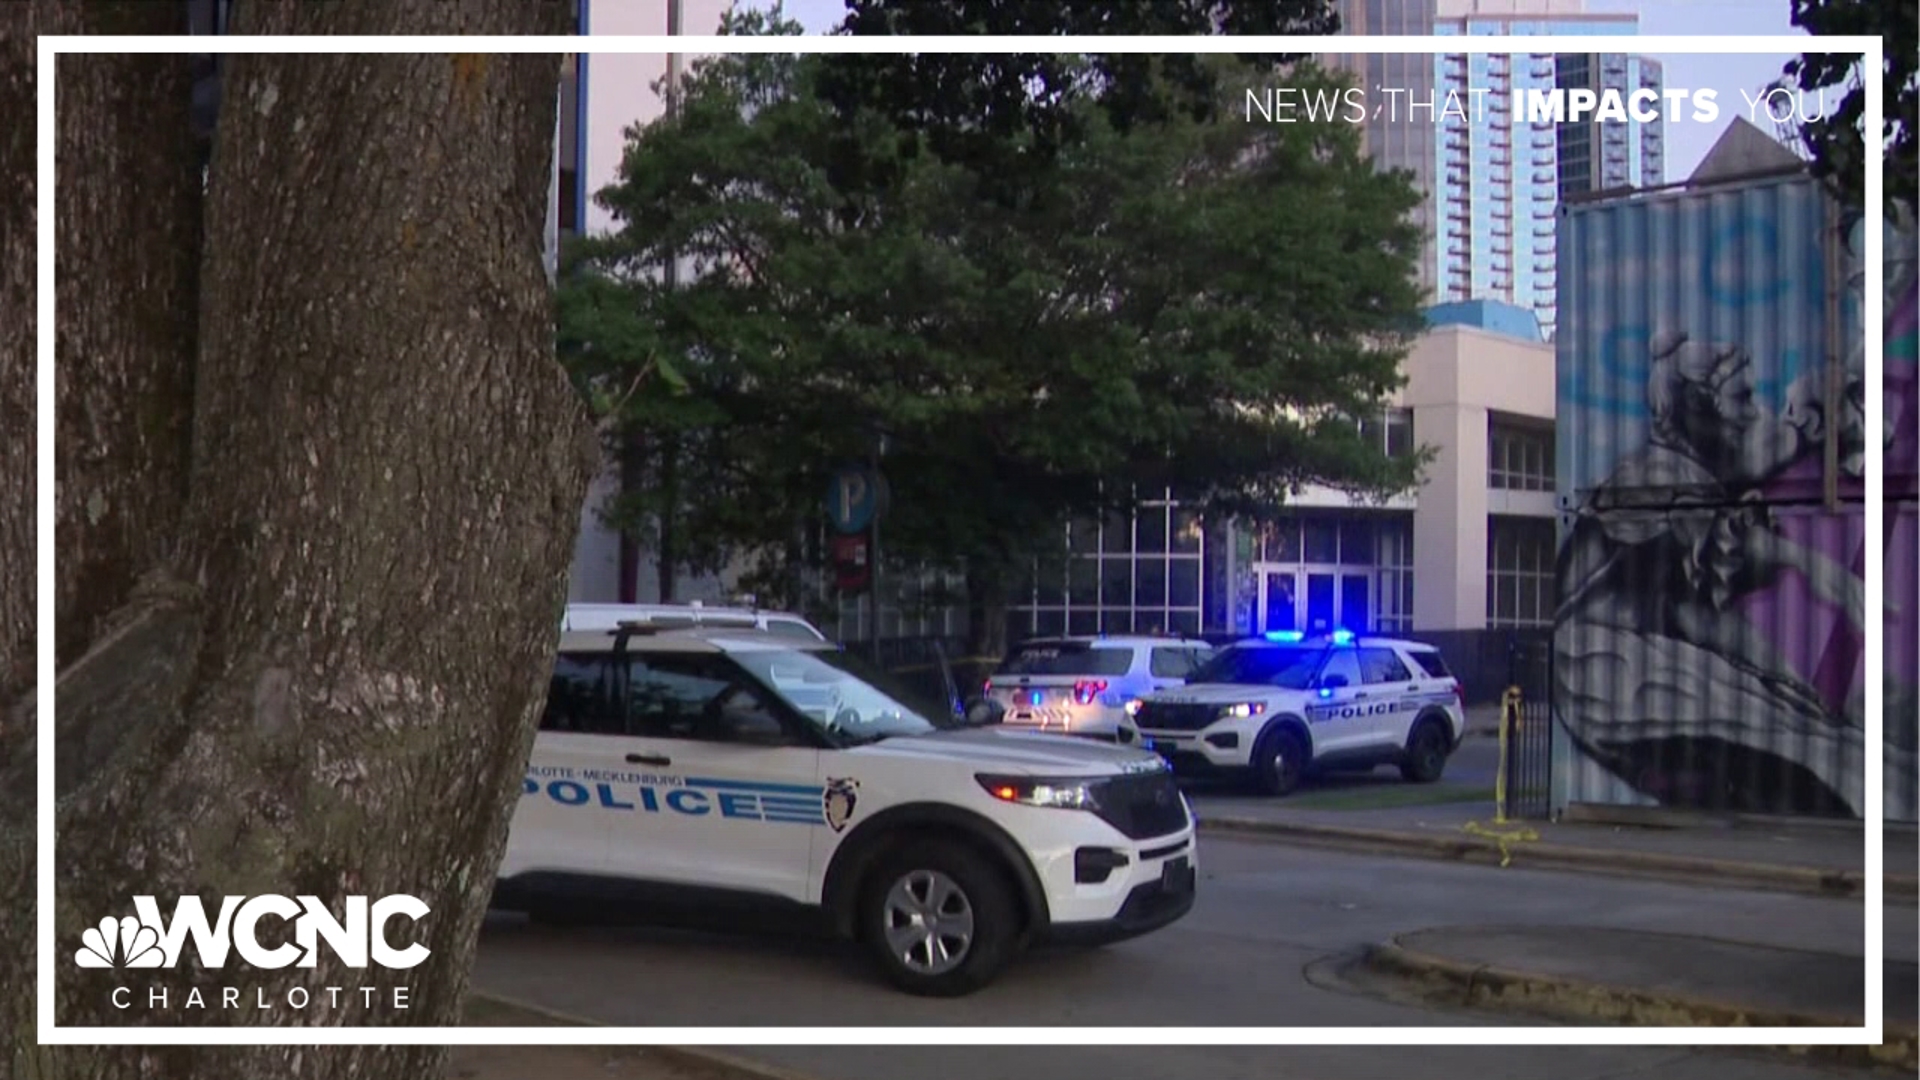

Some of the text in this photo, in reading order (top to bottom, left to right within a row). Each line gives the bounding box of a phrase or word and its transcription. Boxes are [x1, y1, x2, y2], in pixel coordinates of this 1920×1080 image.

[839, 472, 867, 523] P
[1327, 702, 1399, 720] POLICE
[583, 768, 682, 788] MECKLENBURG
